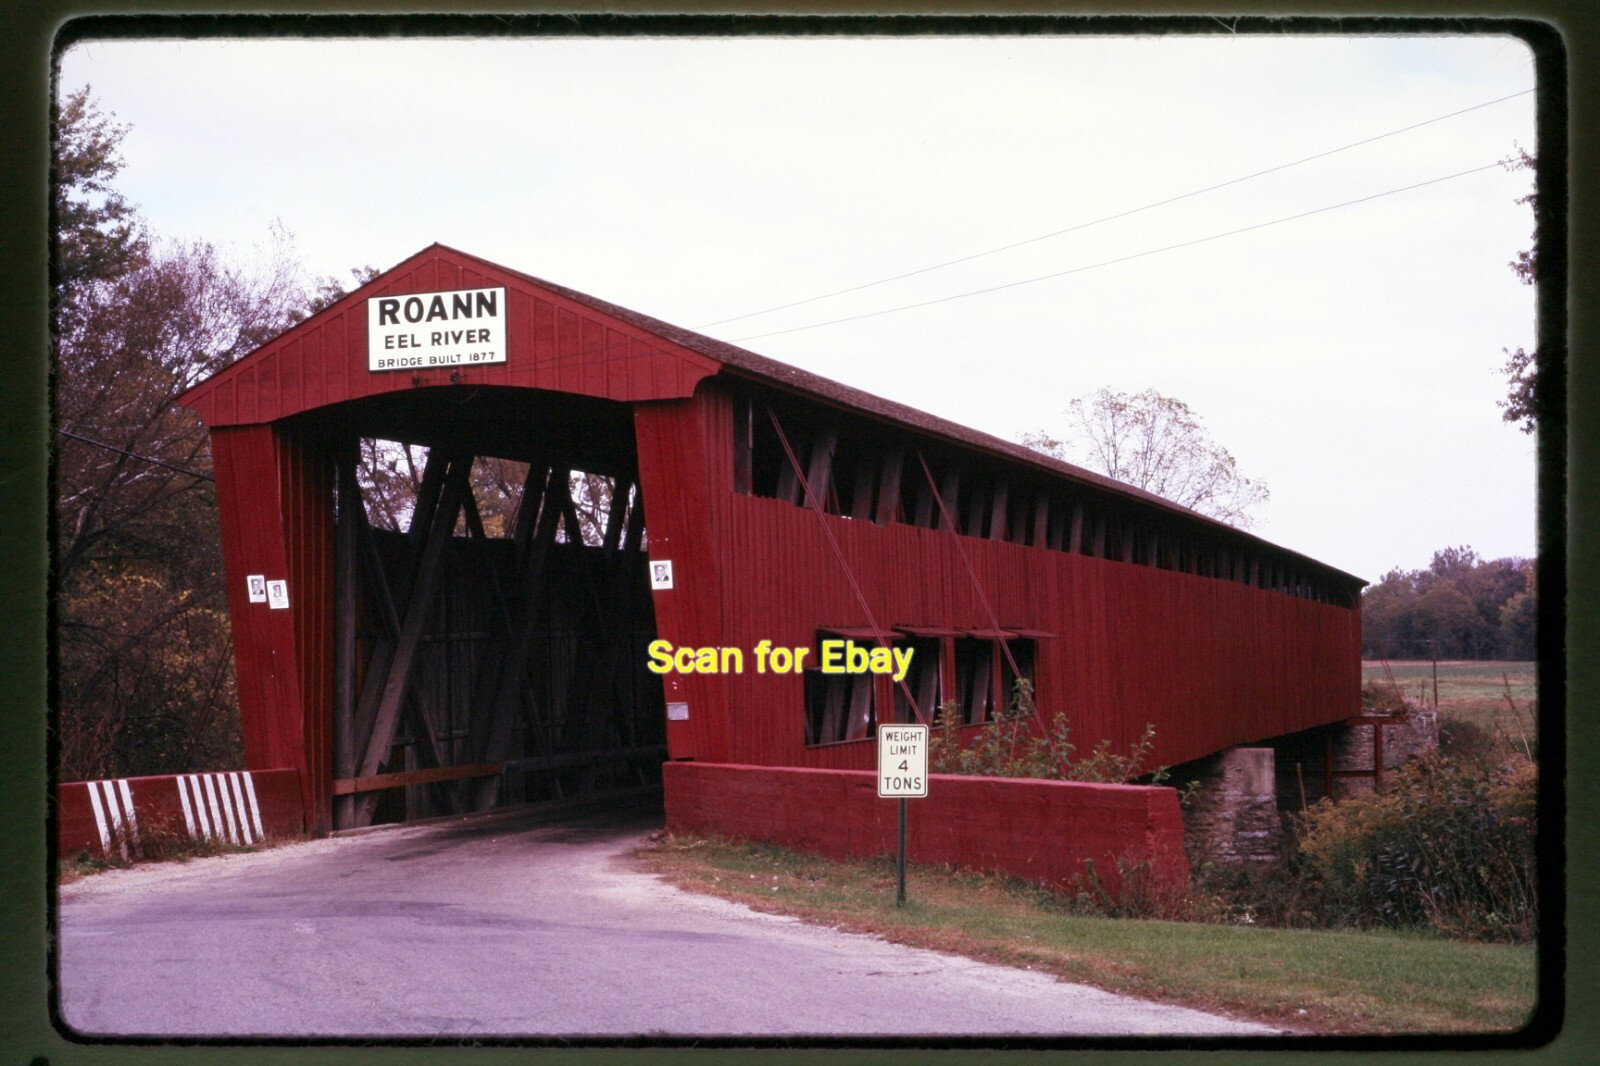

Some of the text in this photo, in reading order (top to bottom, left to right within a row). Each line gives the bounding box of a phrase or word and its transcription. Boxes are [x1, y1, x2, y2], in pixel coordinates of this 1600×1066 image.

[379, 291, 497, 326] ROANN
[385, 328, 491, 349] EEL RIVER
[378, 352, 495, 368] BRIDGE BUILT 1877
[886, 732, 922, 741] WEIGHT
[890, 746, 917, 755] LIMIT
[898, 760, 908, 772] 4
[884, 777, 921, 790] TONS
